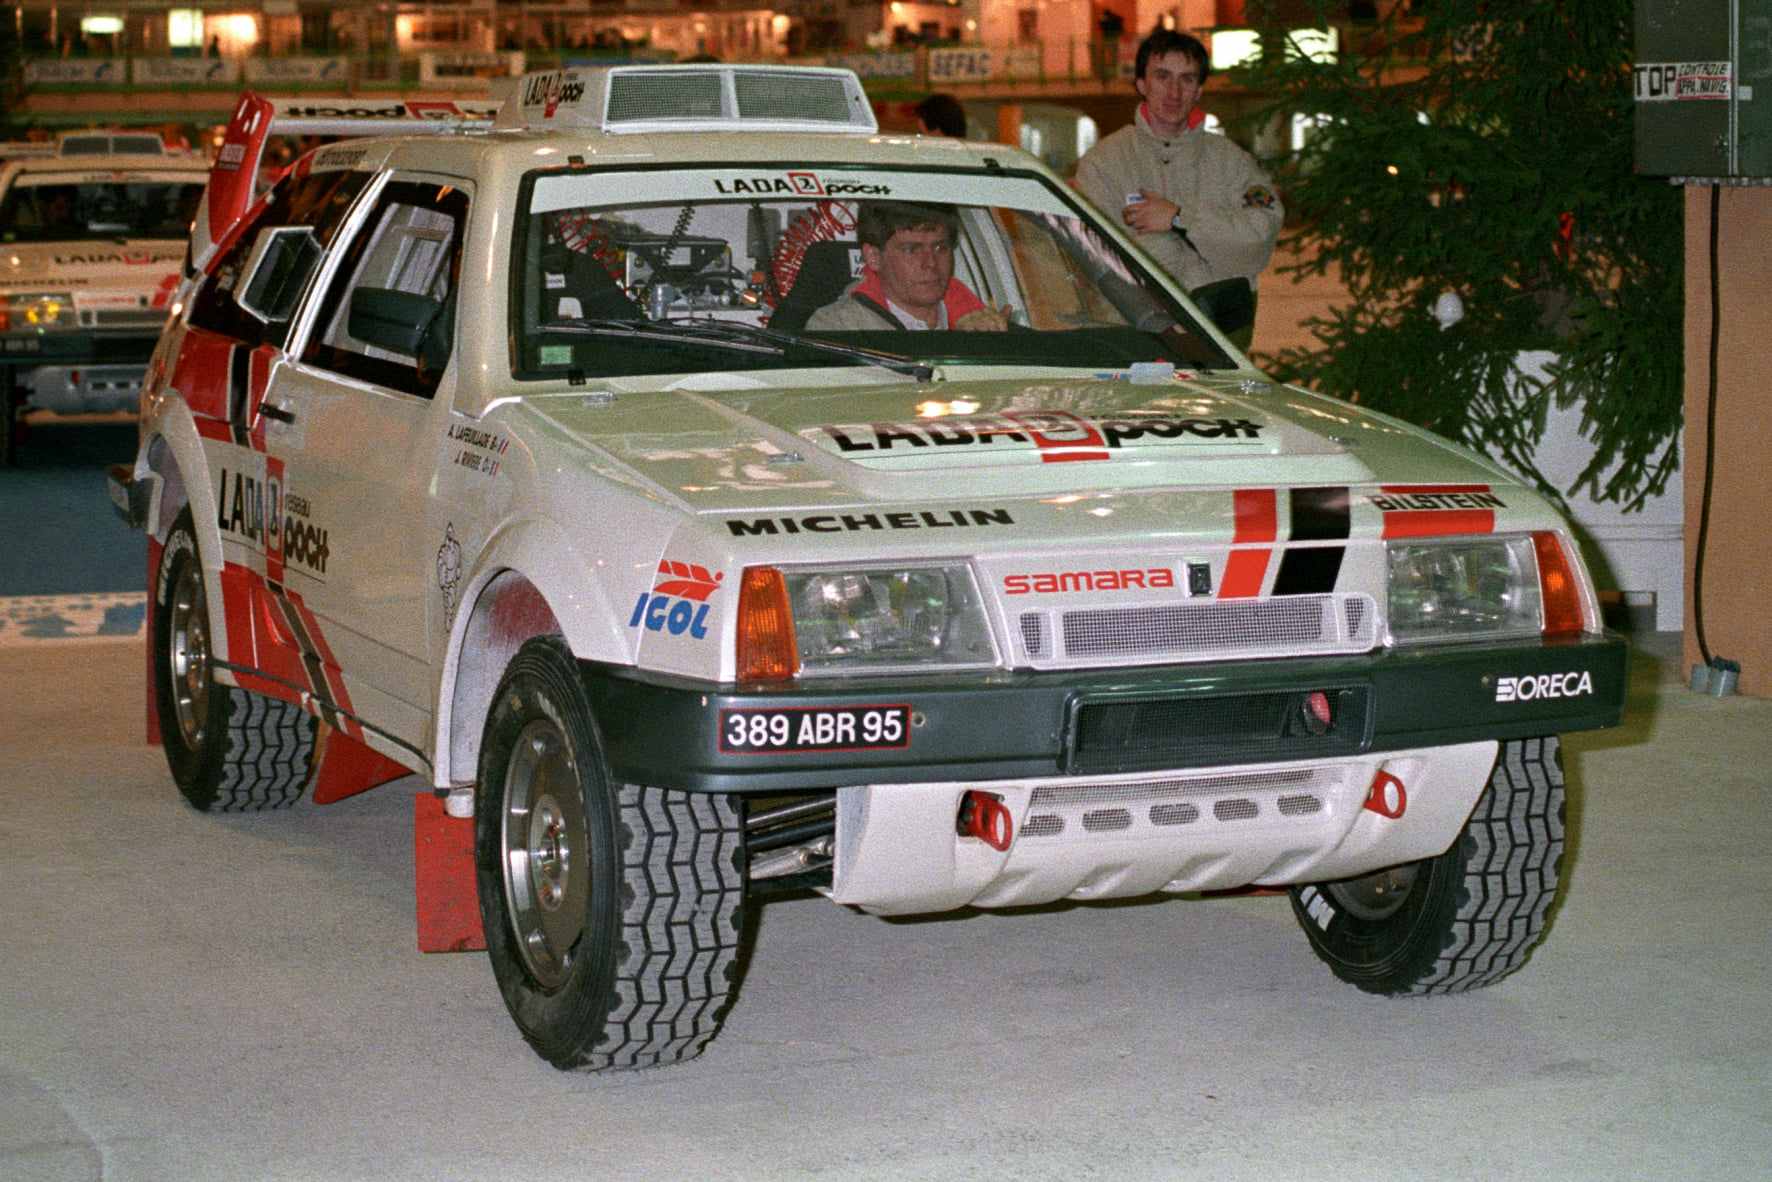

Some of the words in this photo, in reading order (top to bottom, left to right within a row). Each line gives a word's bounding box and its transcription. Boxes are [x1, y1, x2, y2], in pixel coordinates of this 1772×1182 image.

[1634, 65, 1676, 97] TOP
[714, 177, 794, 194] LADA
[821, 419, 1029, 451] LADA
[218, 467, 265, 546] LADA
[1365, 493, 1508, 511] BILSTEIN
[726, 508, 1015, 537] MICHELIN
[628, 592, 711, 641] IGOL
[1516, 670, 1593, 701] ORECA
[727, 714, 790, 747] 389
[796, 712, 857, 745] ABR
[862, 710, 902, 743] 95
